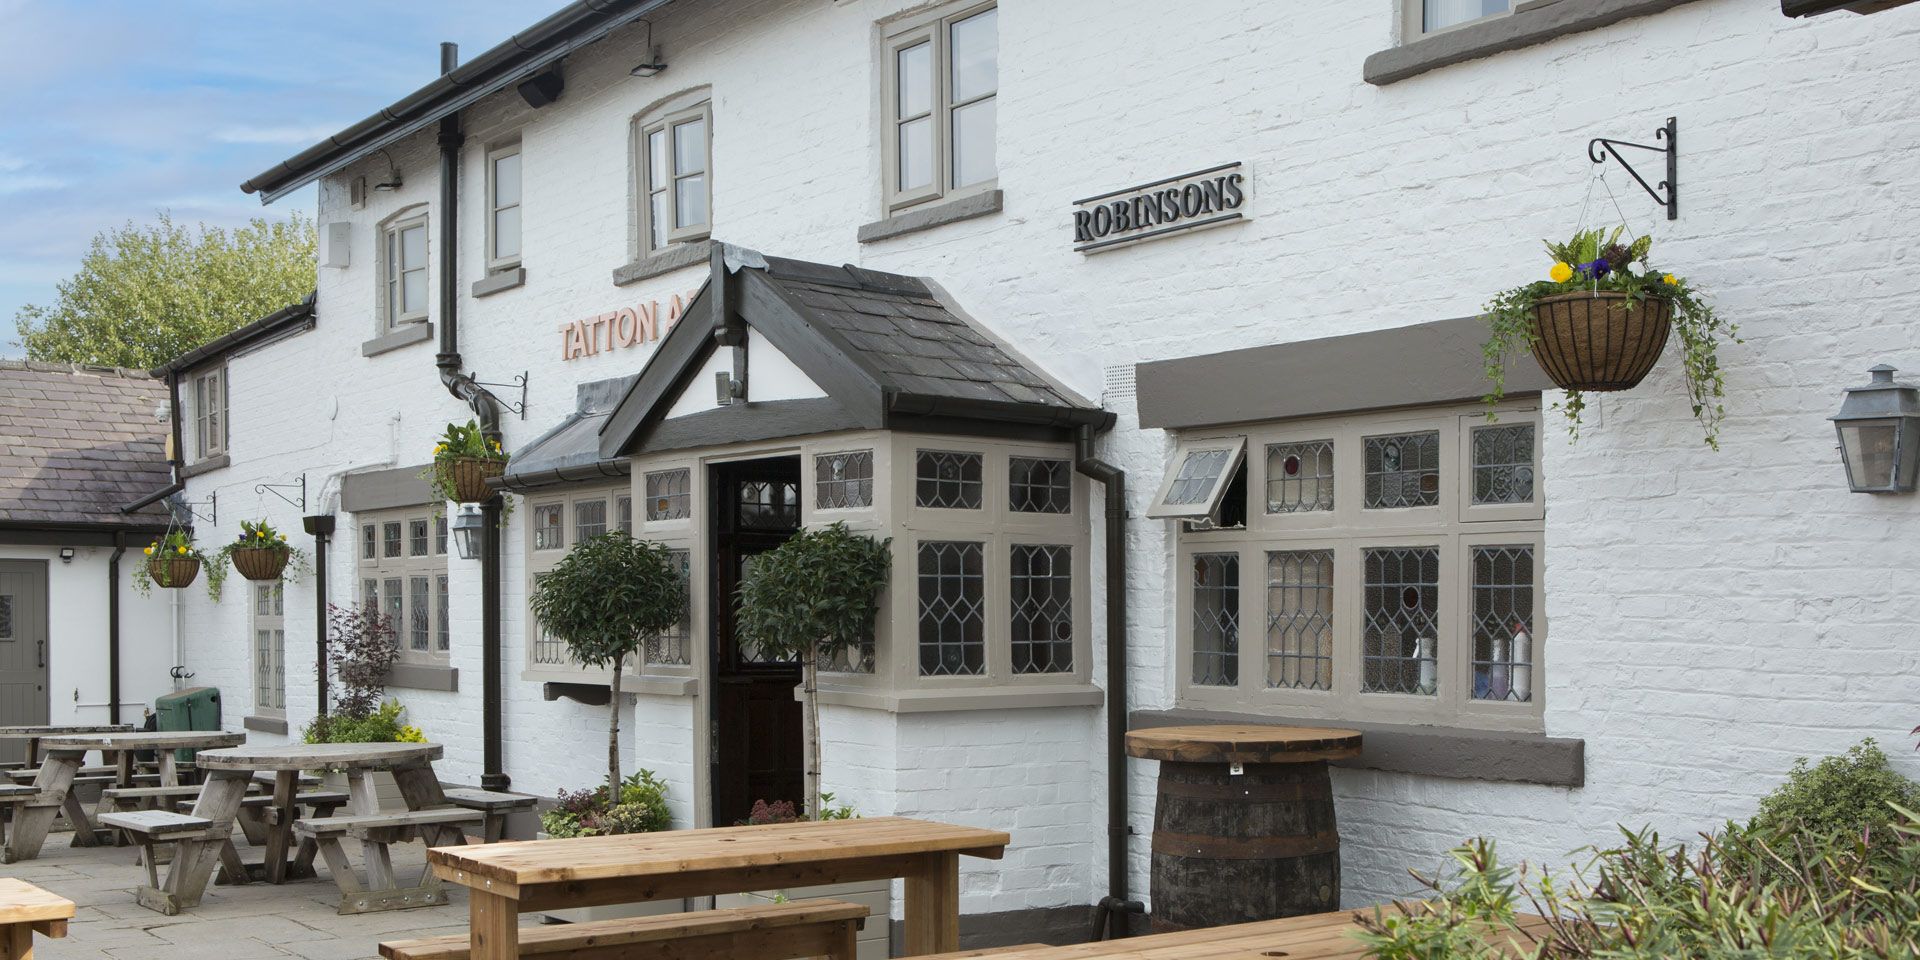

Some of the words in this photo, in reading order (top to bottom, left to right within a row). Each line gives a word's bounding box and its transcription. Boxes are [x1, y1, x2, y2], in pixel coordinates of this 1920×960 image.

[1073, 173, 1243, 242] ROBINSONS
[558, 300, 658, 361] TATTON
[664, 289, 699, 336] A
